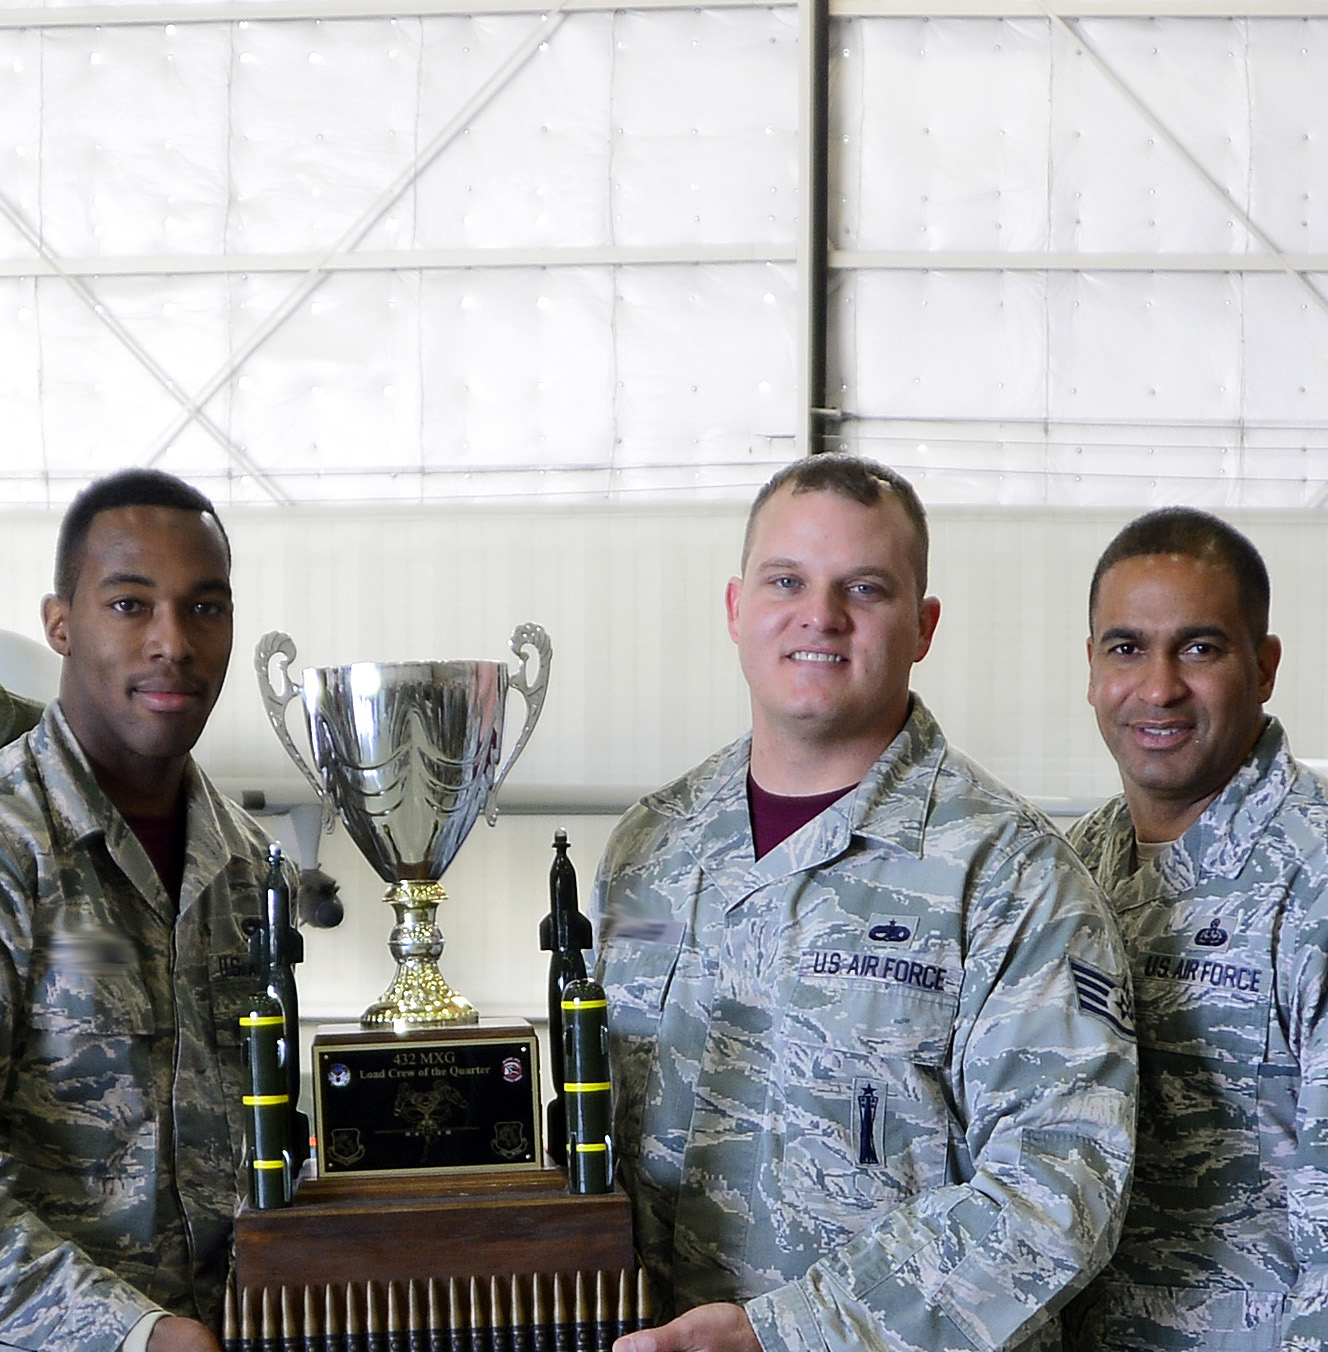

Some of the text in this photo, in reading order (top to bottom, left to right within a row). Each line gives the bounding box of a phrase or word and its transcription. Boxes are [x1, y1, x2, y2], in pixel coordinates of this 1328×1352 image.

[847, 954, 879, 977] AIR
[883, 958, 947, 991] FORCE
[1173, 958, 1199, 981] AIR
[1200, 960, 1262, 992] FORCE
[393, 1051, 456, 1065] 432 MXG
[360, 1069, 385, 1079] Load
[388, 1068, 415, 1079] Crew
[418, 1066, 429, 1077] of
[431, 1066, 447, 1076] the
[449, 1065, 491, 1077] Quarter
